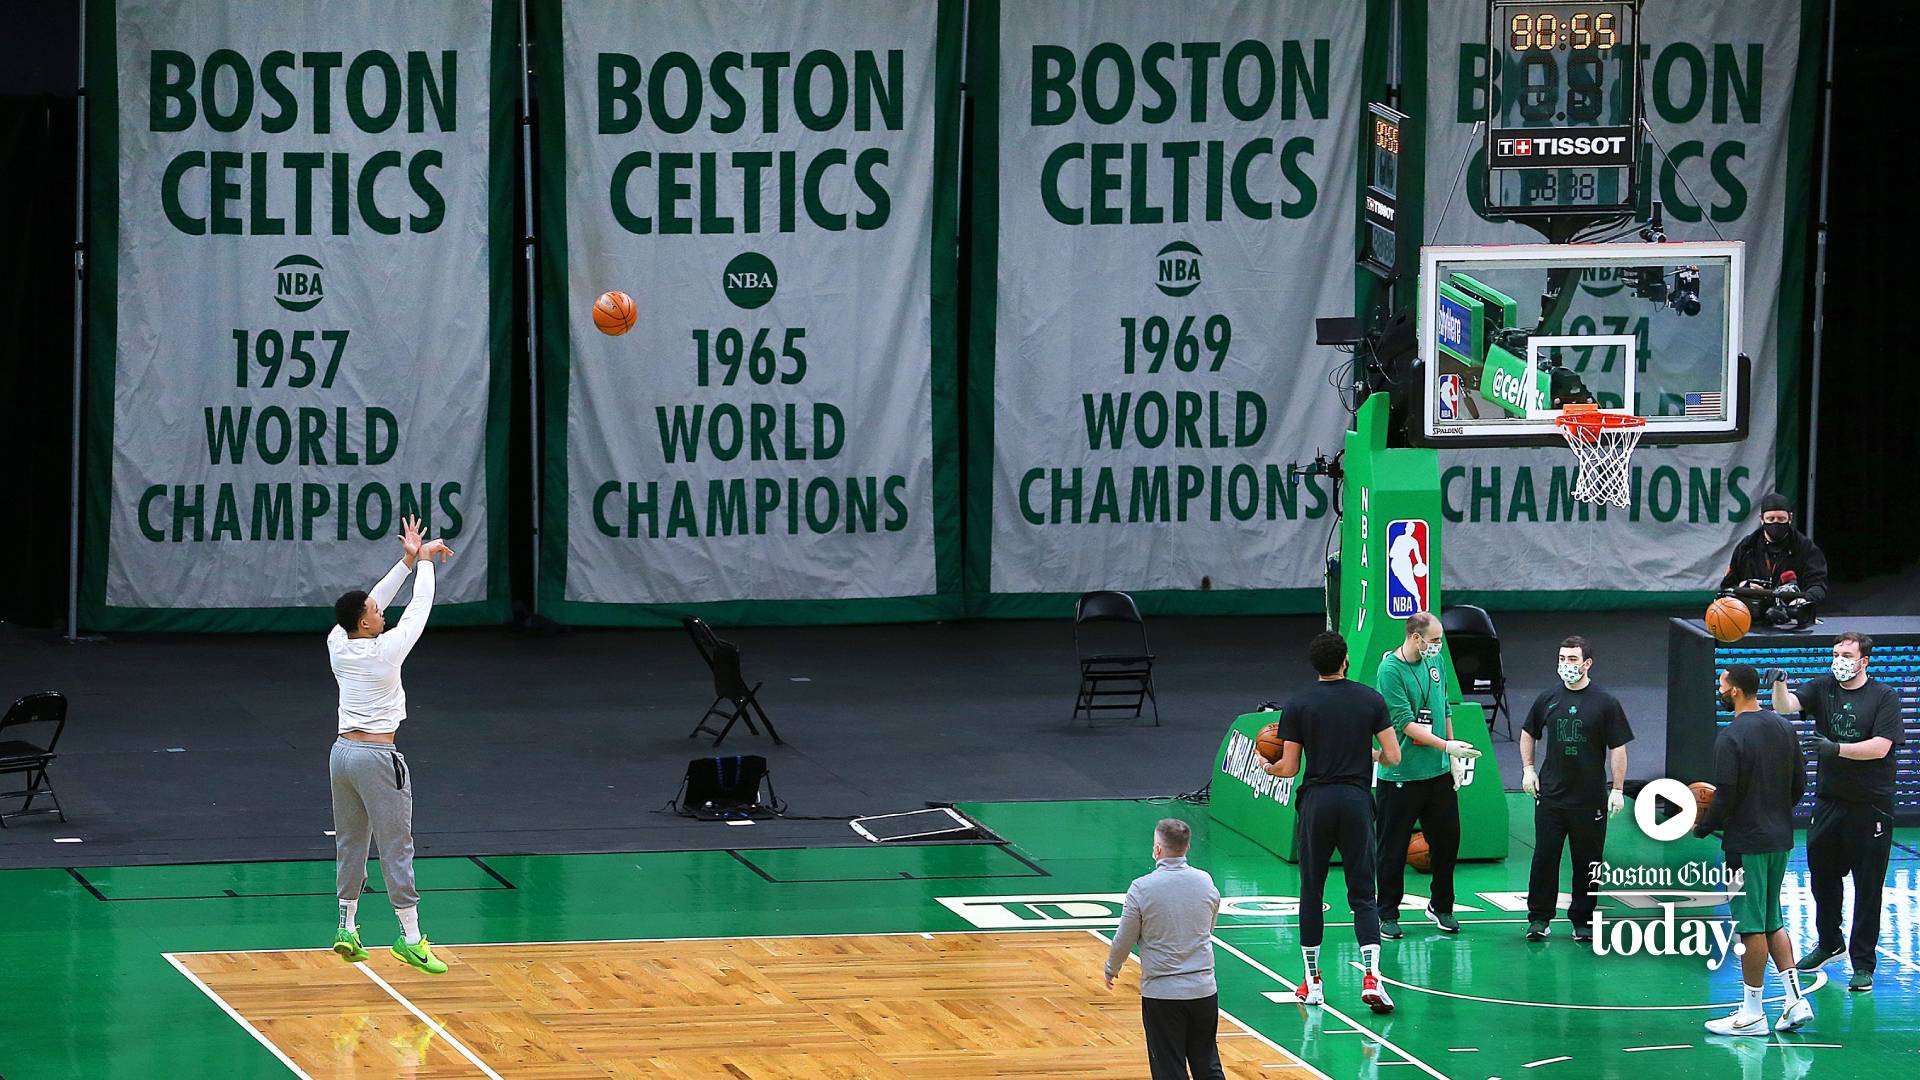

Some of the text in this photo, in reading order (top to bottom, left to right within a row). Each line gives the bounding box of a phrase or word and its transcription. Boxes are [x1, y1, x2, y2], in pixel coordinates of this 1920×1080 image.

[1511, 13, 1617, 51] 90:55
[150, 49, 457, 134] BOSTON
[598, 50, 903, 134] BOSTON
[1031, 39, 1330, 126] BOSTON
[1533, 137, 1626, 156] TISSOT
[161, 150, 445, 235] CELTICS
[610, 148, 890, 234] CELTICS
[1041, 137, 1318, 225] CELTICS
[278, 272, 323, 295] NBA
[727, 272, 774, 289] NBA
[1158, 258, 1201, 282] NBA
[233, 329, 349, 388] 1957
[693, 328, 806, 386] 1965
[1121, 315, 1231, 374] 1969
[205, 406, 398, 465] WORLD
[656, 403, 845, 463] WORLD
[1082, 391, 1267, 450] WORLD
[1433, 427, 1464, 435] SPALDING
[138, 481, 463, 541] CHAMPIONS
[593, 475, 908, 538] CHAMPIONS
[1019, 463, 1329, 525] CHAMPIONS
[1357, 486, 1369, 632] NBA TV
[1393, 597, 1413, 612] NBA
[1564, 746, 1578, 755] 25
